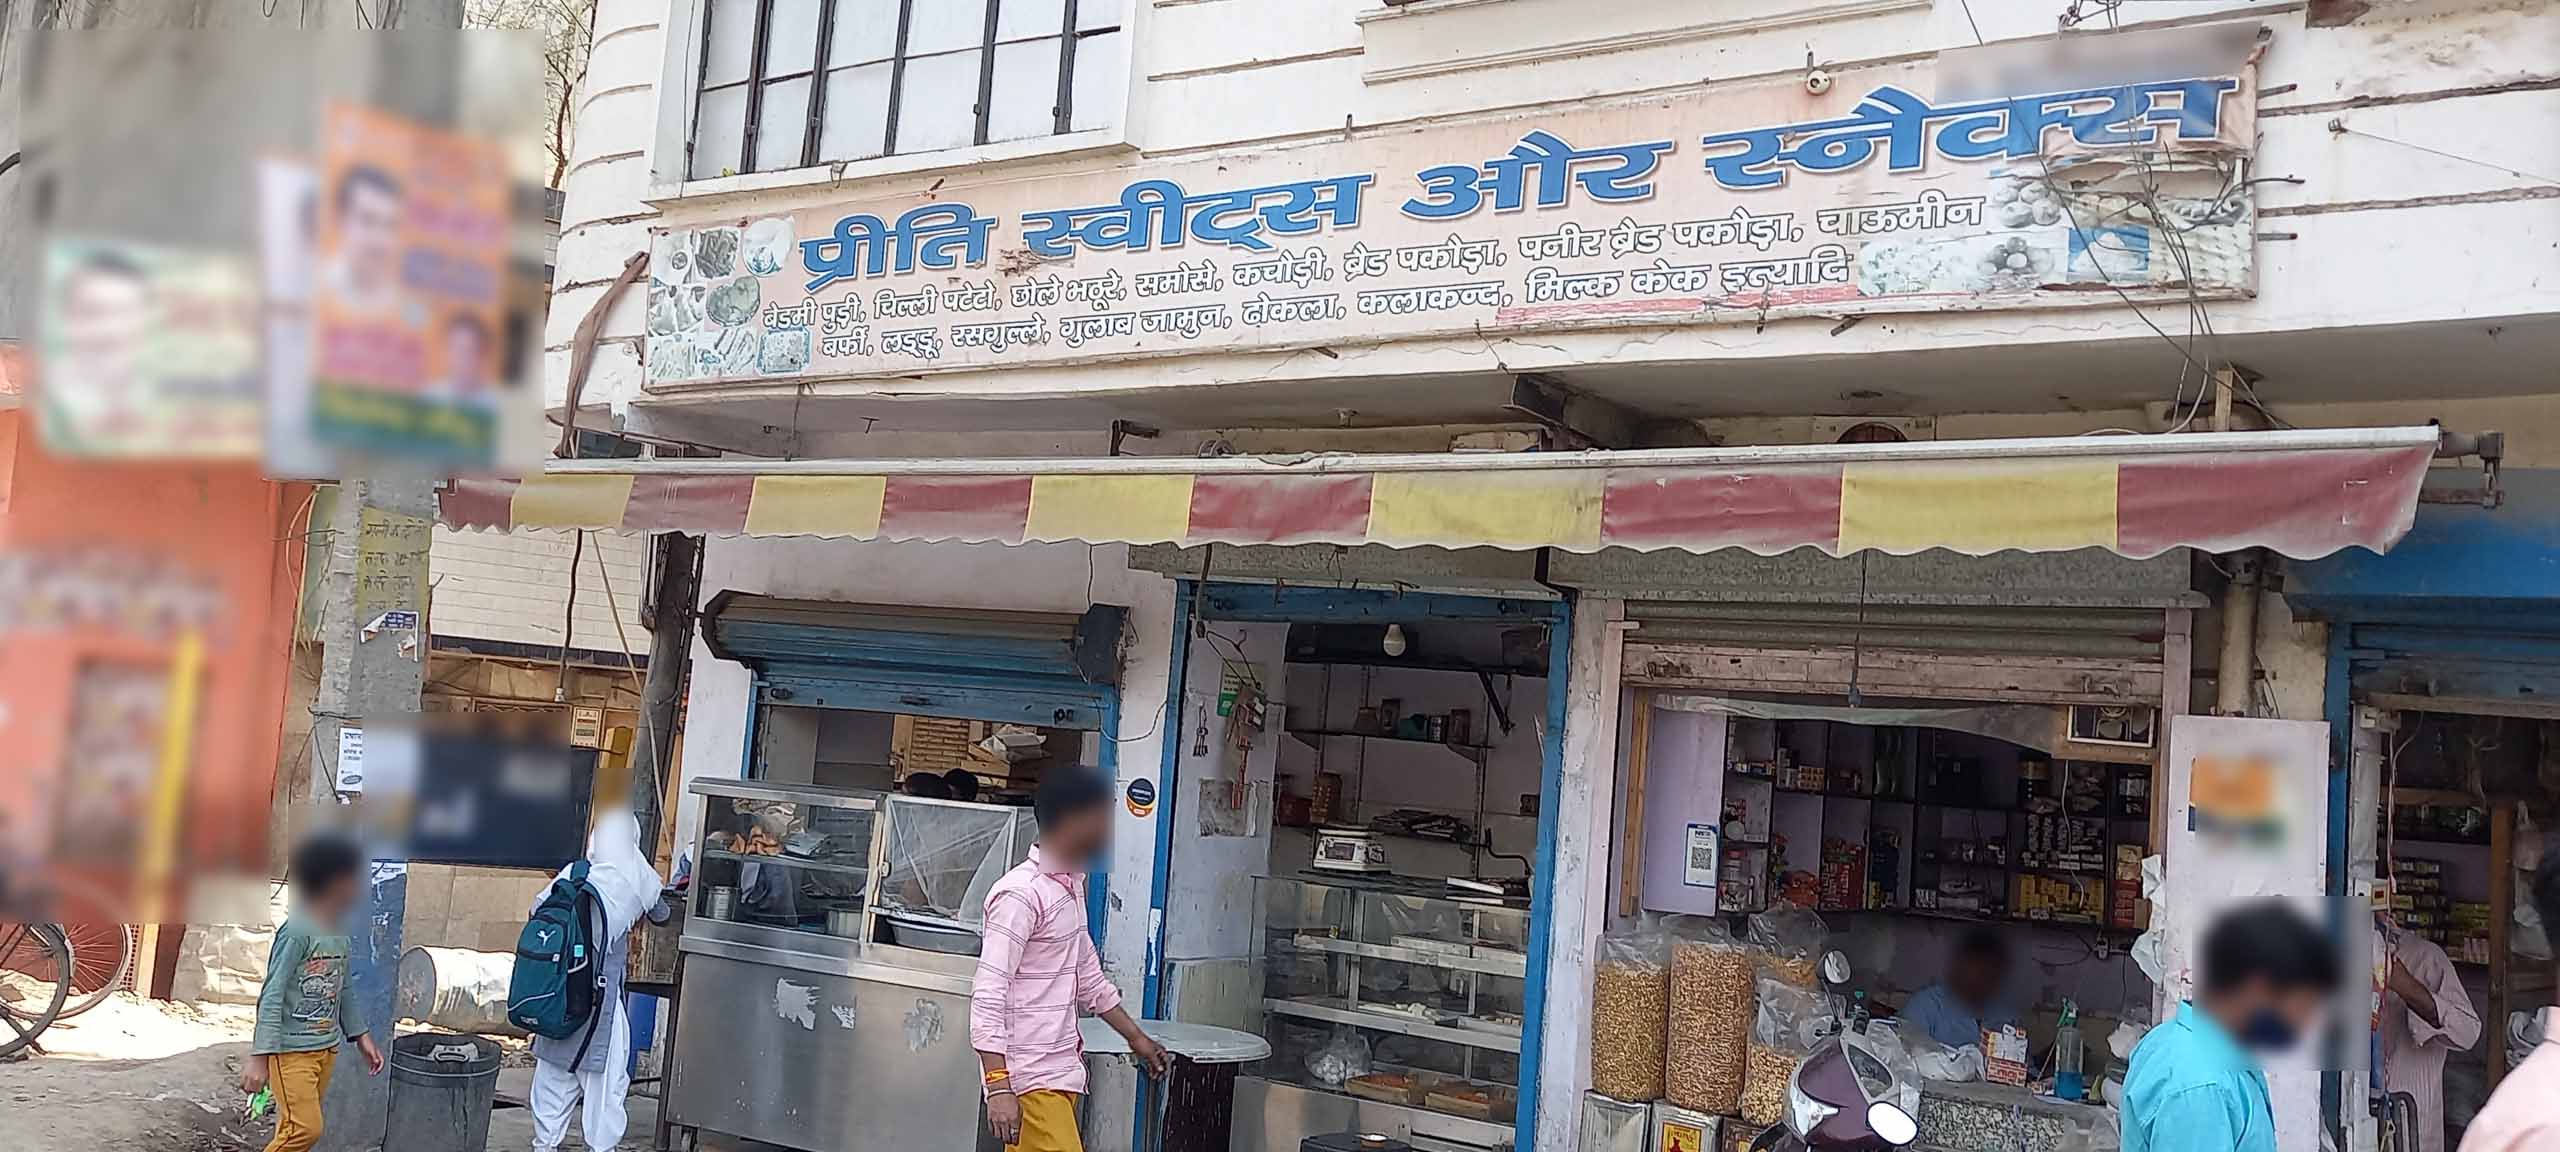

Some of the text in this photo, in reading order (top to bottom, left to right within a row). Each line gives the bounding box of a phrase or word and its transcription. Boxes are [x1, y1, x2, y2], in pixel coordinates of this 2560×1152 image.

[800, 78, 2240, 294] प्रीति स्वीट्स और स्नैक्स
[763, 296, 818, 329] बेडमी
[873, 282, 938, 320] चिल्ली
[942, 278, 1003, 311] पटेटो,
[1010, 273, 1063, 307] छोले
[1065, 268, 1128, 311] भठूरे,
[1136, 259, 1224, 296] समोसे,
[1233, 247, 1334, 288] कचौड़ी,
[1344, 240, 1392, 282] ब्रैड
[1397, 232, 1507, 274] पकौड़ा,
[1518, 222, 1605, 261] पनीर
[1609, 216, 1666, 259] ब्रैड
[1672, 206, 1804, 250] पकौड़ा,
[1817, 189, 1986, 236] चाऊमीन
[822, 325, 874, 357] बर्फी,
[951, 312, 1051, 354] रसगुल्ले,
[1060, 312, 1137, 347] गुलाब
[1142, 304, 1233, 340] जामुन,
[1242, 291, 1347, 325] ढोकला,
[1357, 280, 1513, 315] कलाकन्द,
[1525, 267, 1624, 305] मिल्क
[1631, 258, 1712, 295] केक
[1719, 244, 1855, 294] इत्यादि
